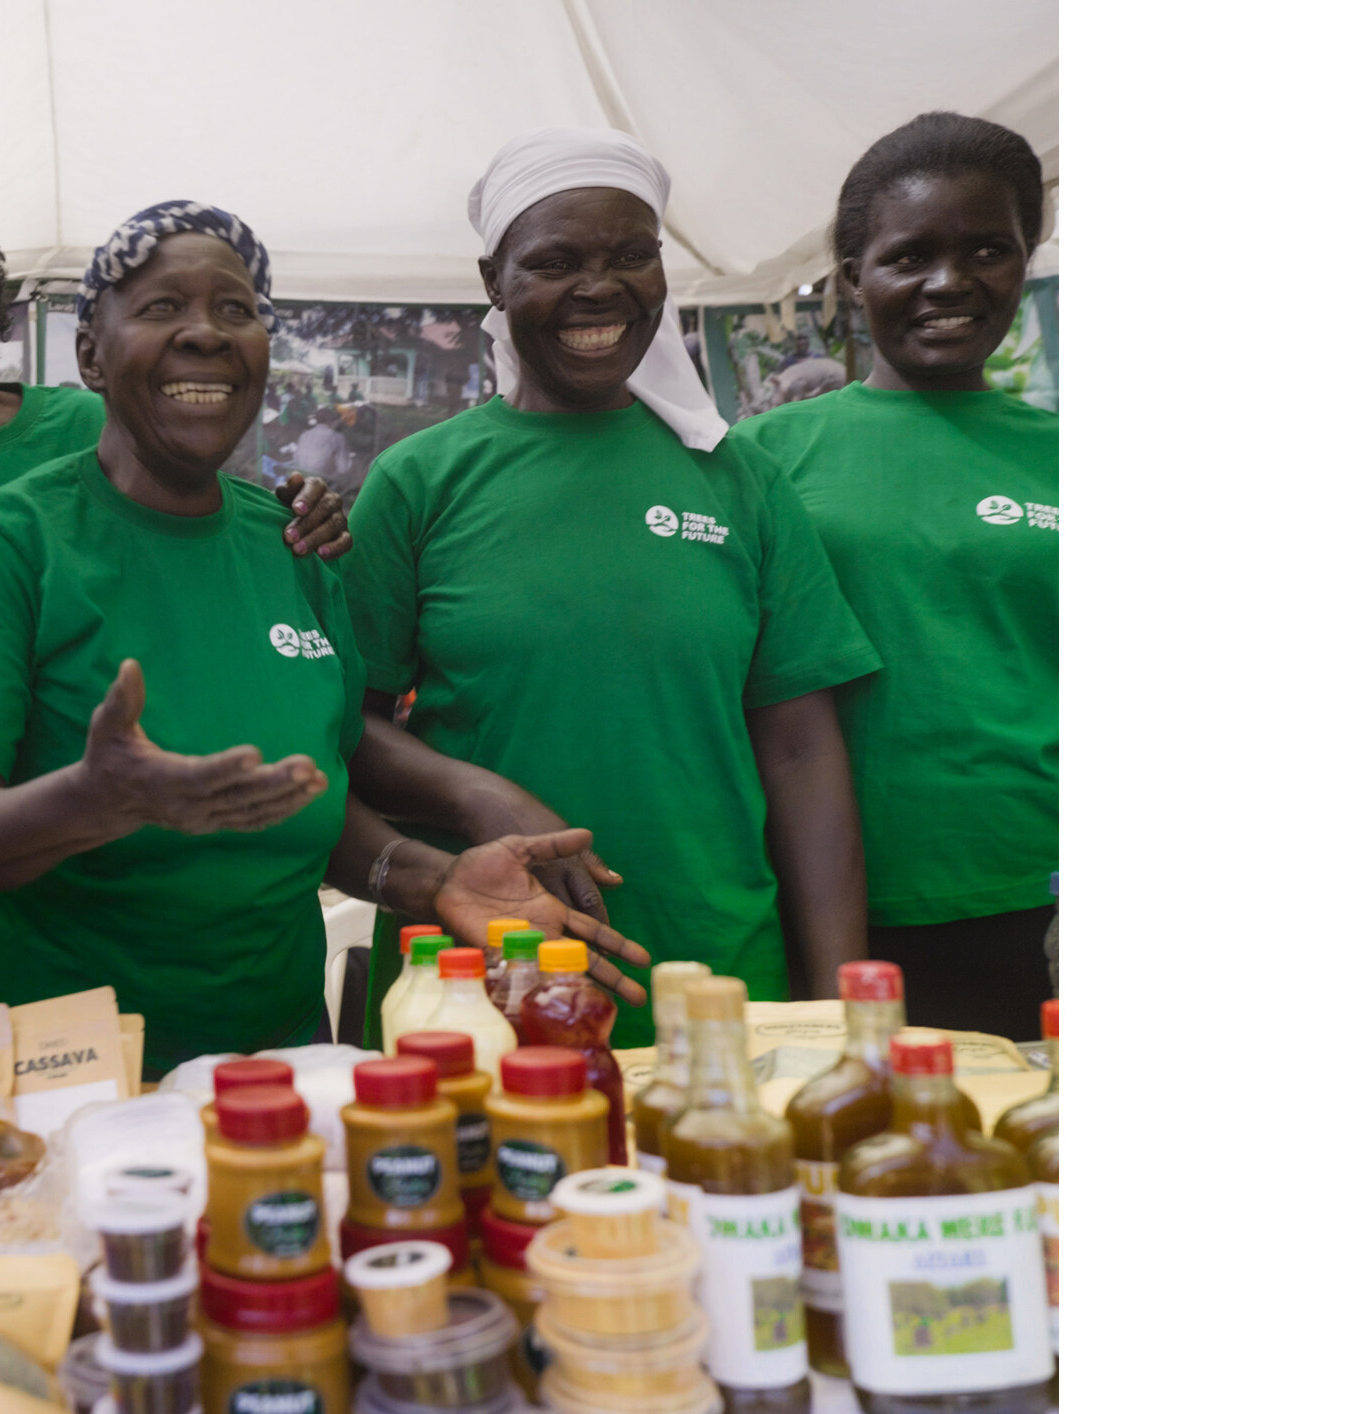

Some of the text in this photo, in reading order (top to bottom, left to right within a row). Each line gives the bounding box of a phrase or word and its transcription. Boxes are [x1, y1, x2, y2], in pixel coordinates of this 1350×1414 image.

[681, 512, 717, 525] TREES
[1024, 502, 1059, 516] TREE
[682, 521, 729, 537] FOR THE
[682, 531, 725, 545] FUTURE
[313, 637, 330, 648] TH
[14, 1048, 99, 1076] CASSAVA
[372, 1154, 435, 1176] PEANUT
[497, 1146, 558, 1174] PEANUT
[252, 1200, 316, 1225] PEANUT
[236, 1390, 315, 1414] PEANUT
